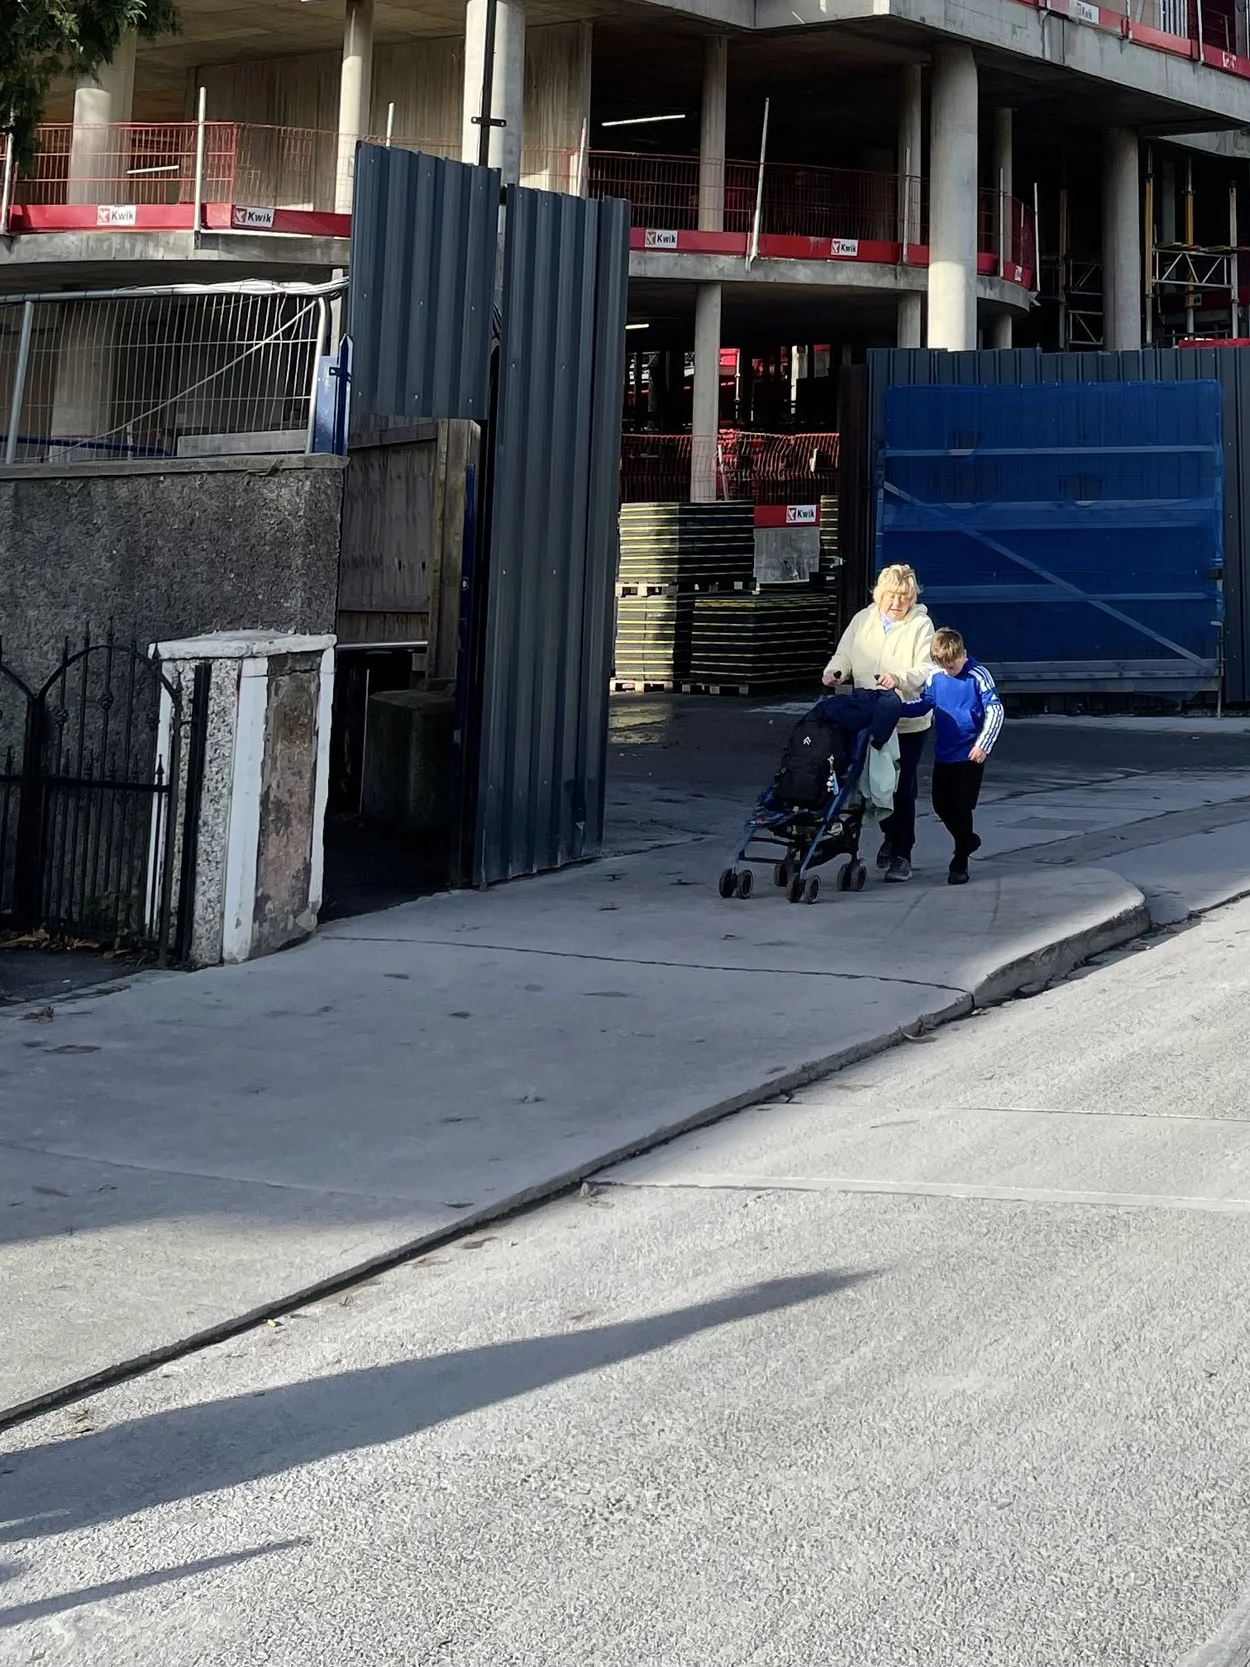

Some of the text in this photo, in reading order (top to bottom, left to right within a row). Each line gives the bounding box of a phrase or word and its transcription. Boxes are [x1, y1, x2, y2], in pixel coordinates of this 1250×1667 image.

[111, 210, 134, 221] Kwik
[247, 211, 272, 223] Kwik
[657, 234, 676, 244] Kwik
[841, 244, 856, 253] Kwik
[797, 509, 814, 518] Kwik
